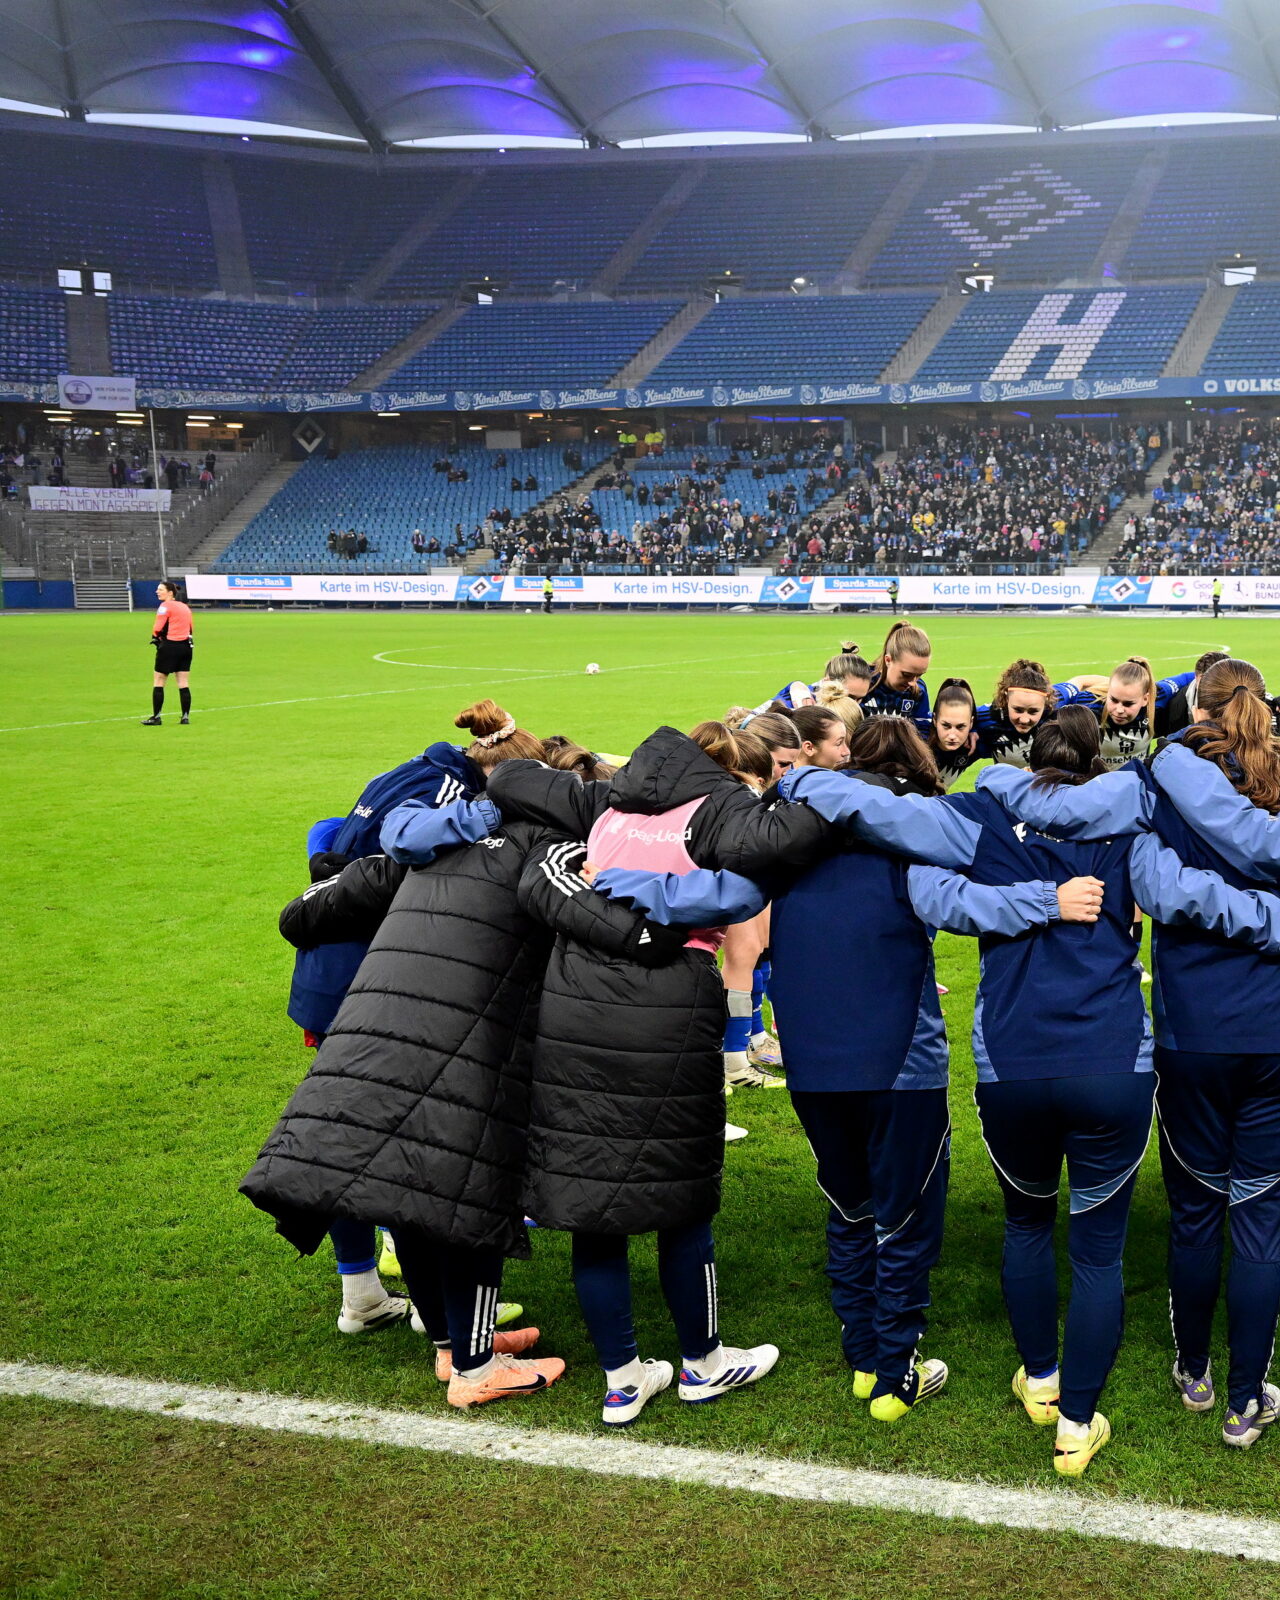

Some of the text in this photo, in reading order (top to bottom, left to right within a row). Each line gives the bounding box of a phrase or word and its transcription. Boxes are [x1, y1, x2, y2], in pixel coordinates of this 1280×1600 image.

[95, 487, 139, 498] VEREINT
[235, 577, 285, 588] Sparda-Bank
[320, 581, 448, 596] Karte im HSV-Design.
[522, 578, 576, 589] SparBank
[613, 582, 753, 597] Karte im HSV-Design.
[933, 582, 1085, 598] Karte im HSV-Design.
[627, 827, 692, 845] pag-Lloyd
